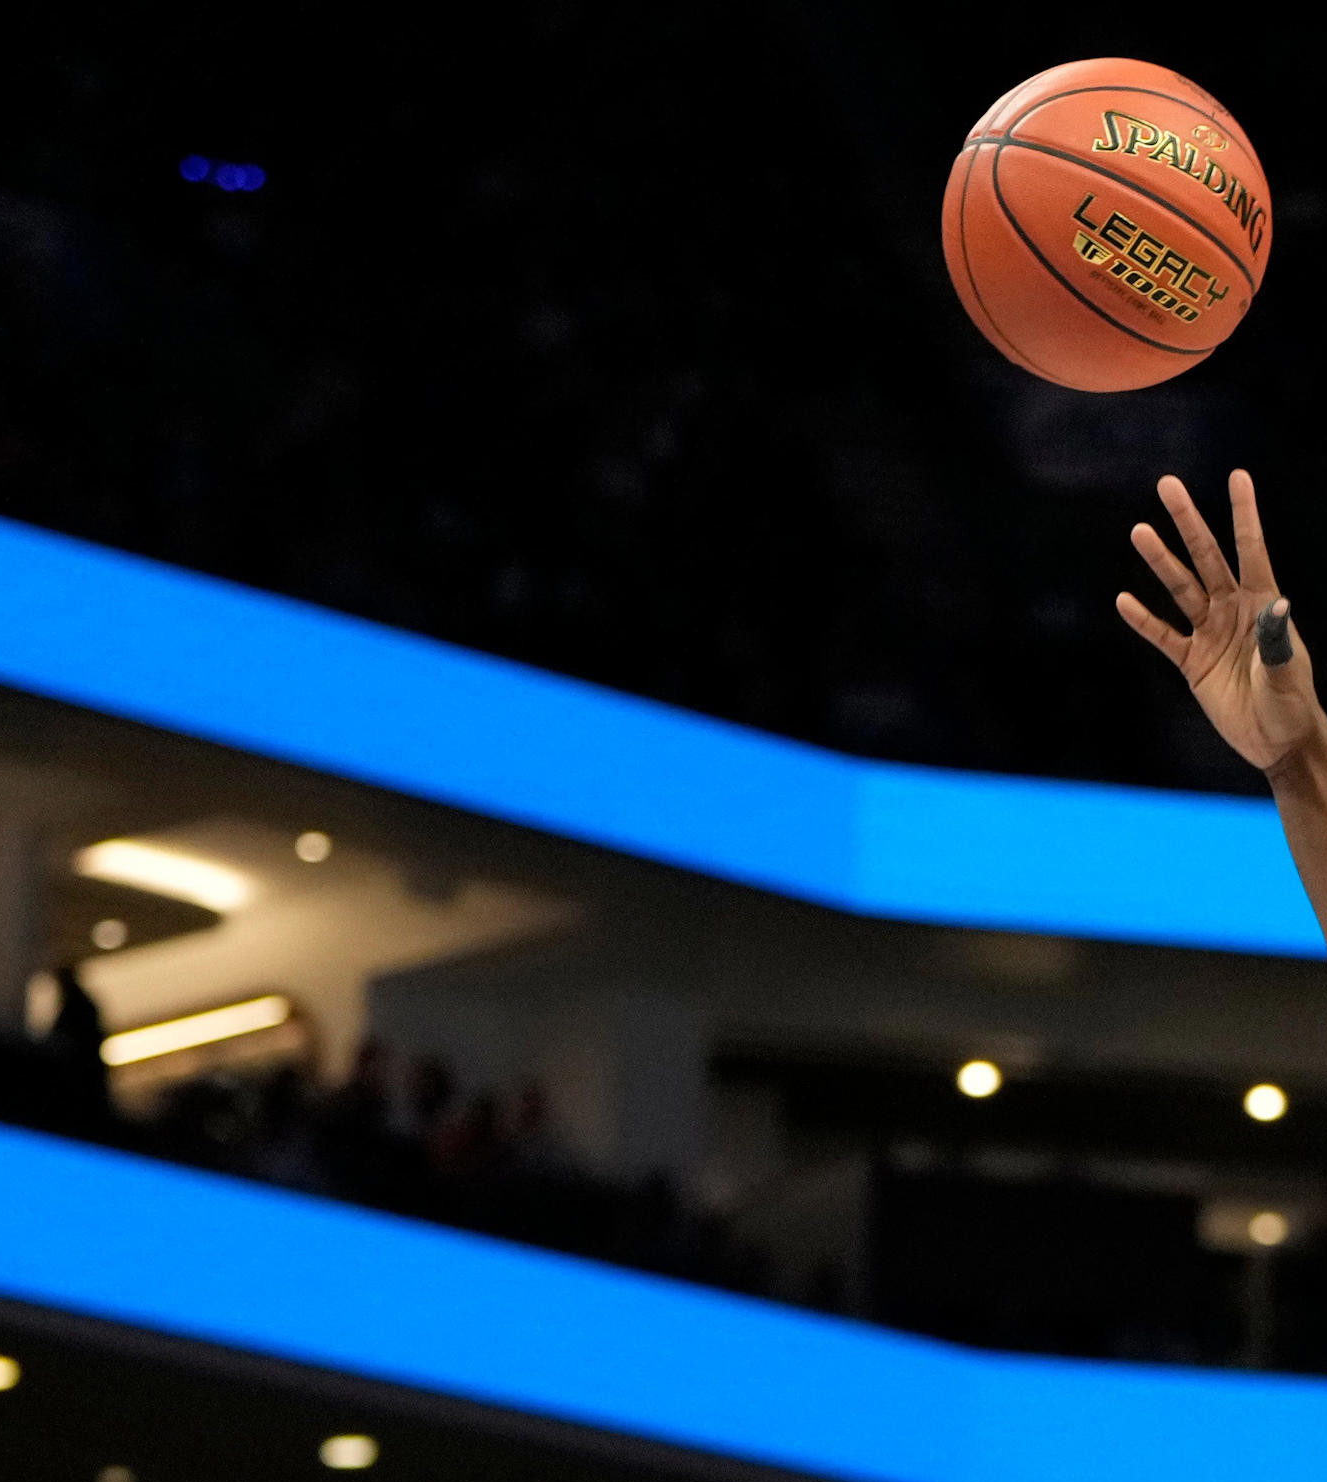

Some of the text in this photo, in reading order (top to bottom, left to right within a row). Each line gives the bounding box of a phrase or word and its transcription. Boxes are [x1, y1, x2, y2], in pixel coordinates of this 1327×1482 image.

[1092, 110, 1267, 259] SPALDING
[1072, 192, 1230, 308] LEGACY
[1106, 259, 1201, 323] 1000
